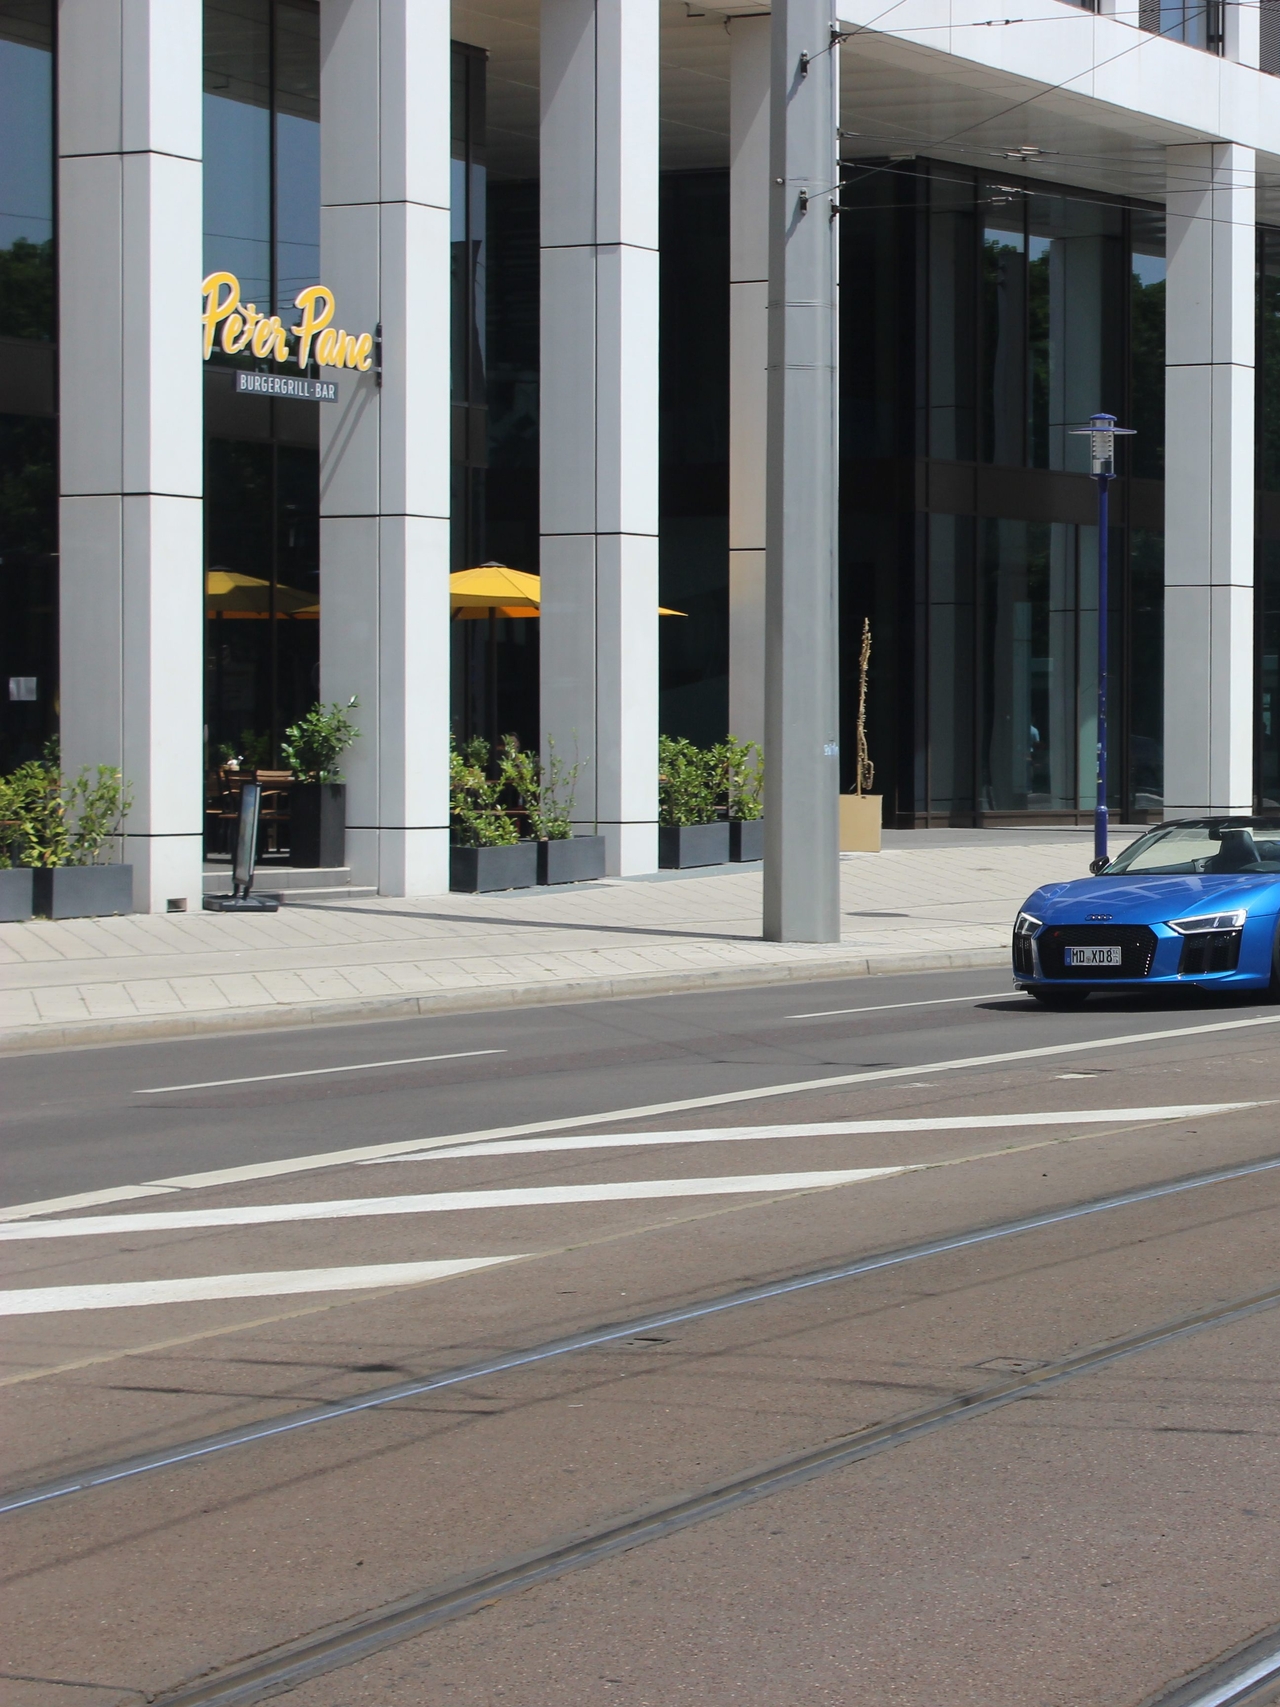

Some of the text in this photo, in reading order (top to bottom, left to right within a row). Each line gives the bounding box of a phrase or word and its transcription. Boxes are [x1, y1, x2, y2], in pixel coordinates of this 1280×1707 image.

[202, 271, 373, 371] Peter Pane
[1072, 949, 1085, 963] MD
